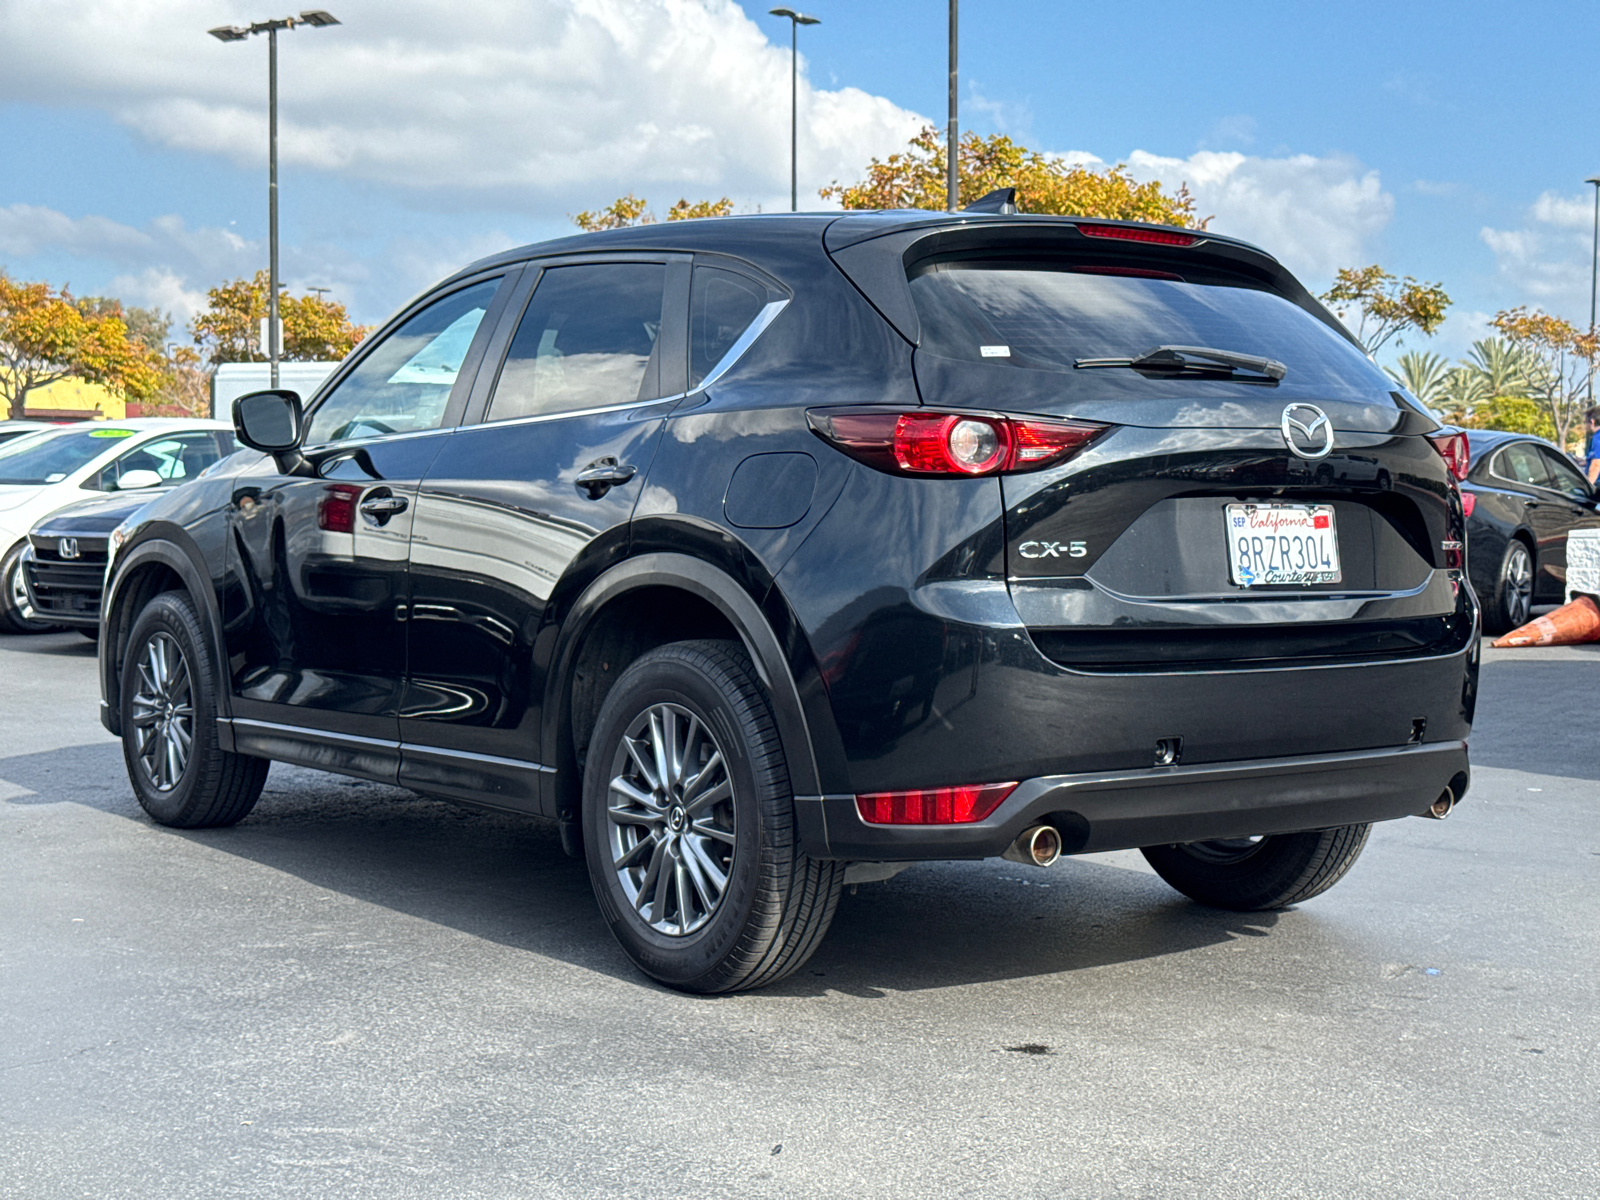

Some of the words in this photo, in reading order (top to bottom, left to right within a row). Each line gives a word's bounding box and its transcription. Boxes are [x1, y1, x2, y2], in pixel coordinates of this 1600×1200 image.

[1233, 517, 1245, 527] SEP
[1250, 510, 1315, 533] California
[1018, 540, 1087, 559] CX-5
[1238, 535, 1331, 571] 8RZR304
